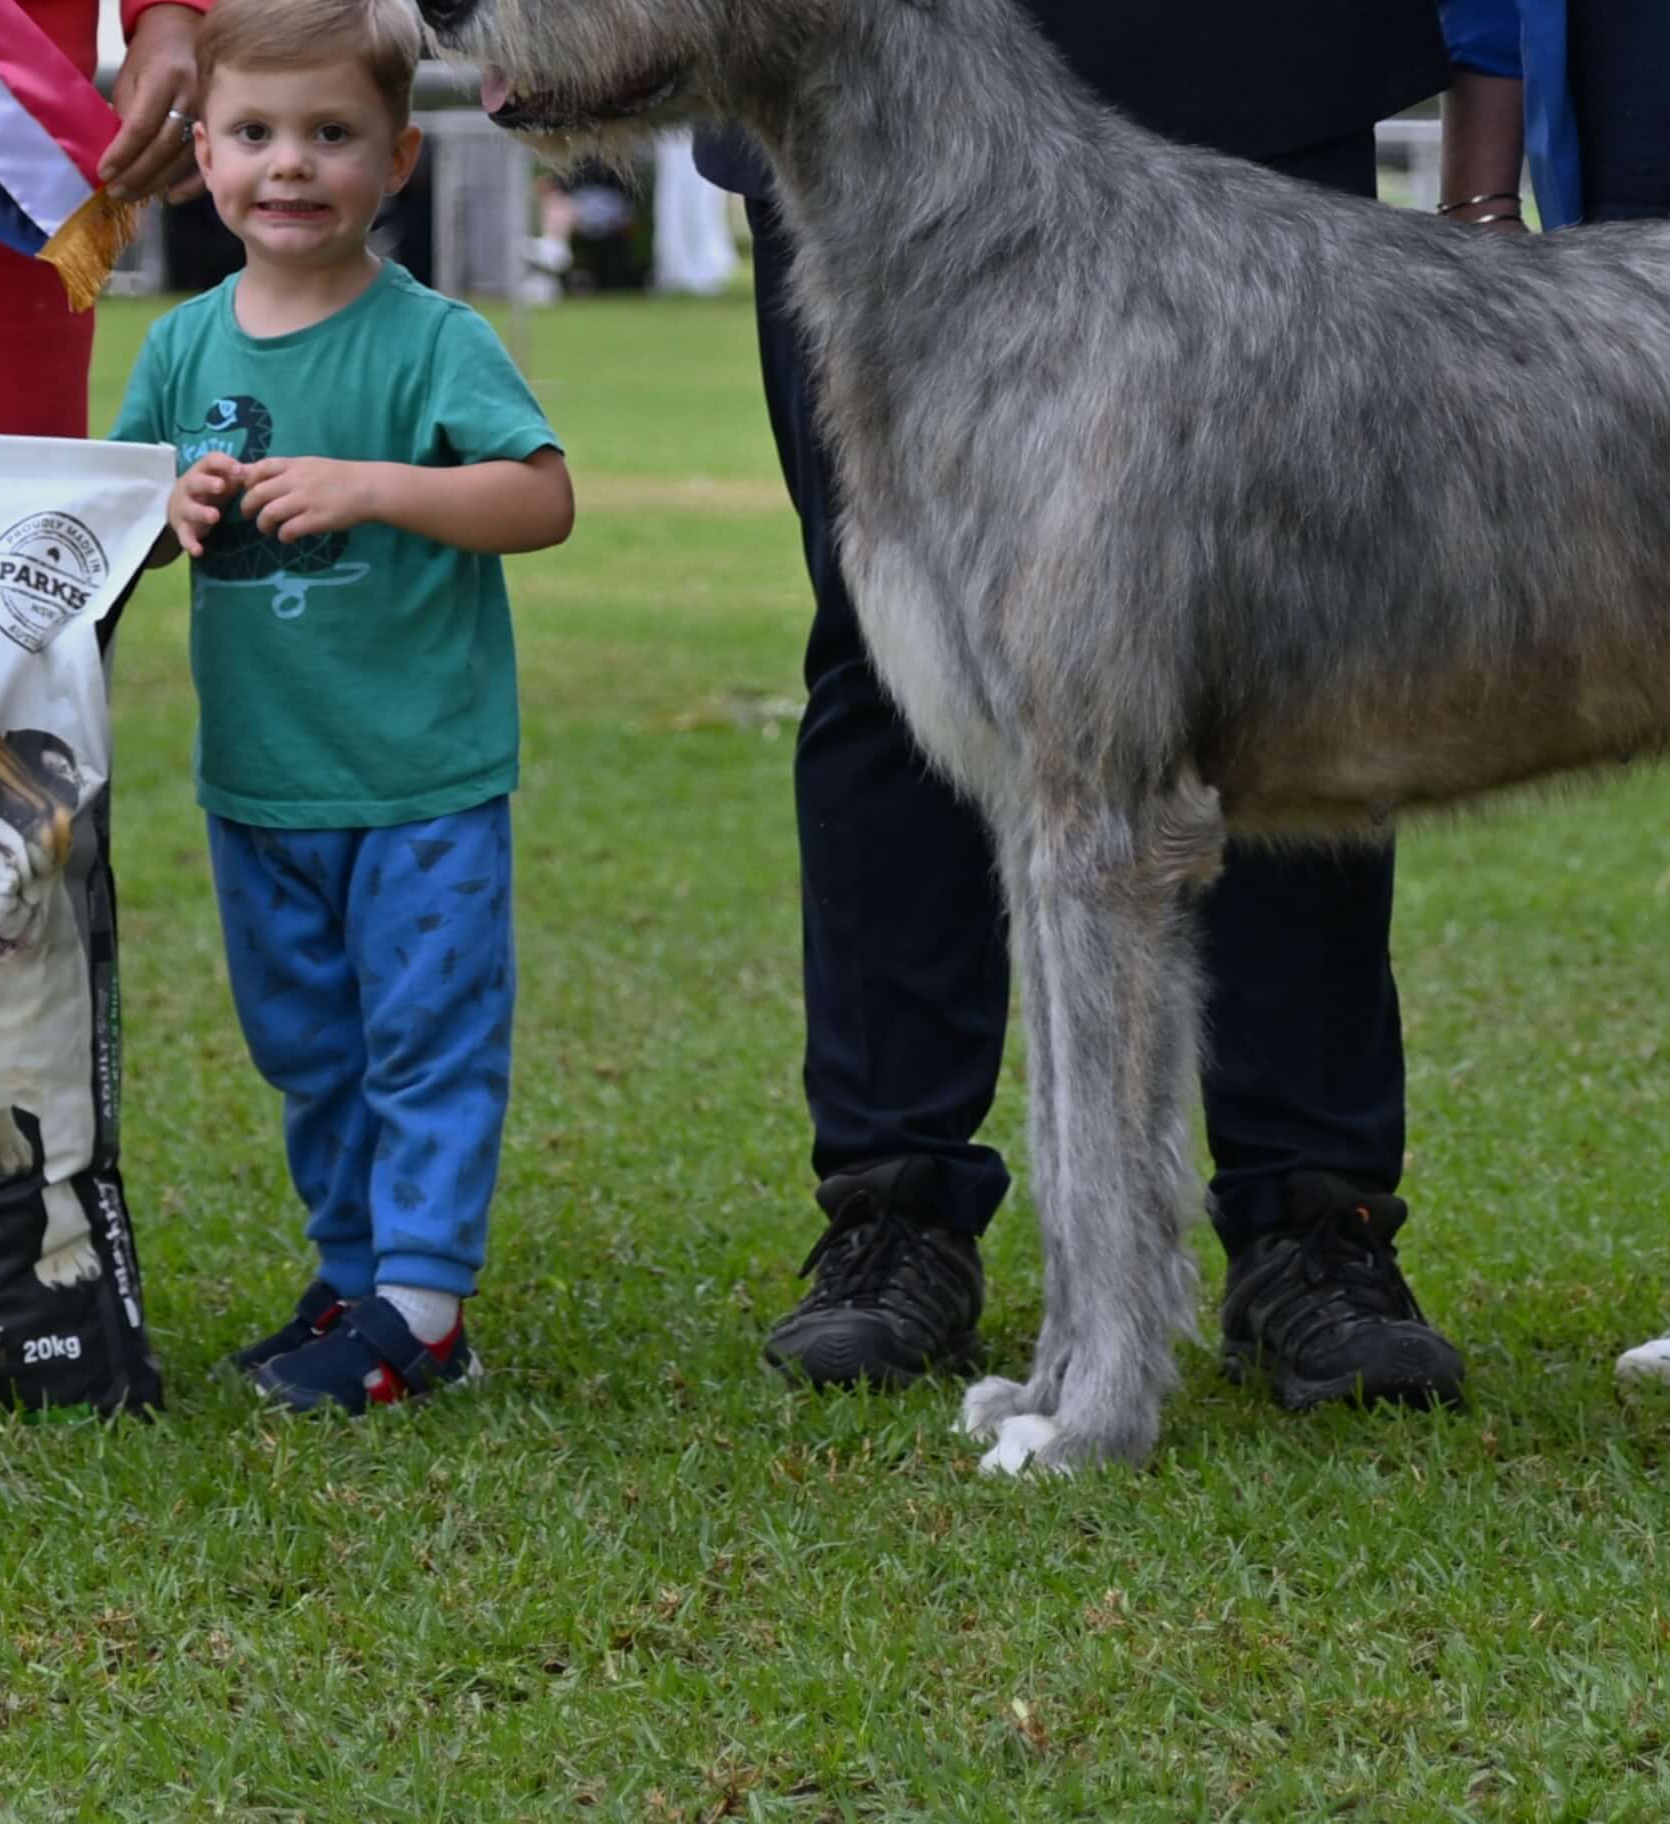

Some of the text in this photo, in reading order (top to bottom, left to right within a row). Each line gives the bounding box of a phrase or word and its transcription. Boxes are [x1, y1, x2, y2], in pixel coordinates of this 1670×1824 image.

[5, 517, 102, 574] PROUDLY MADE IN
[23, 1334, 82, 1364] 20kg
